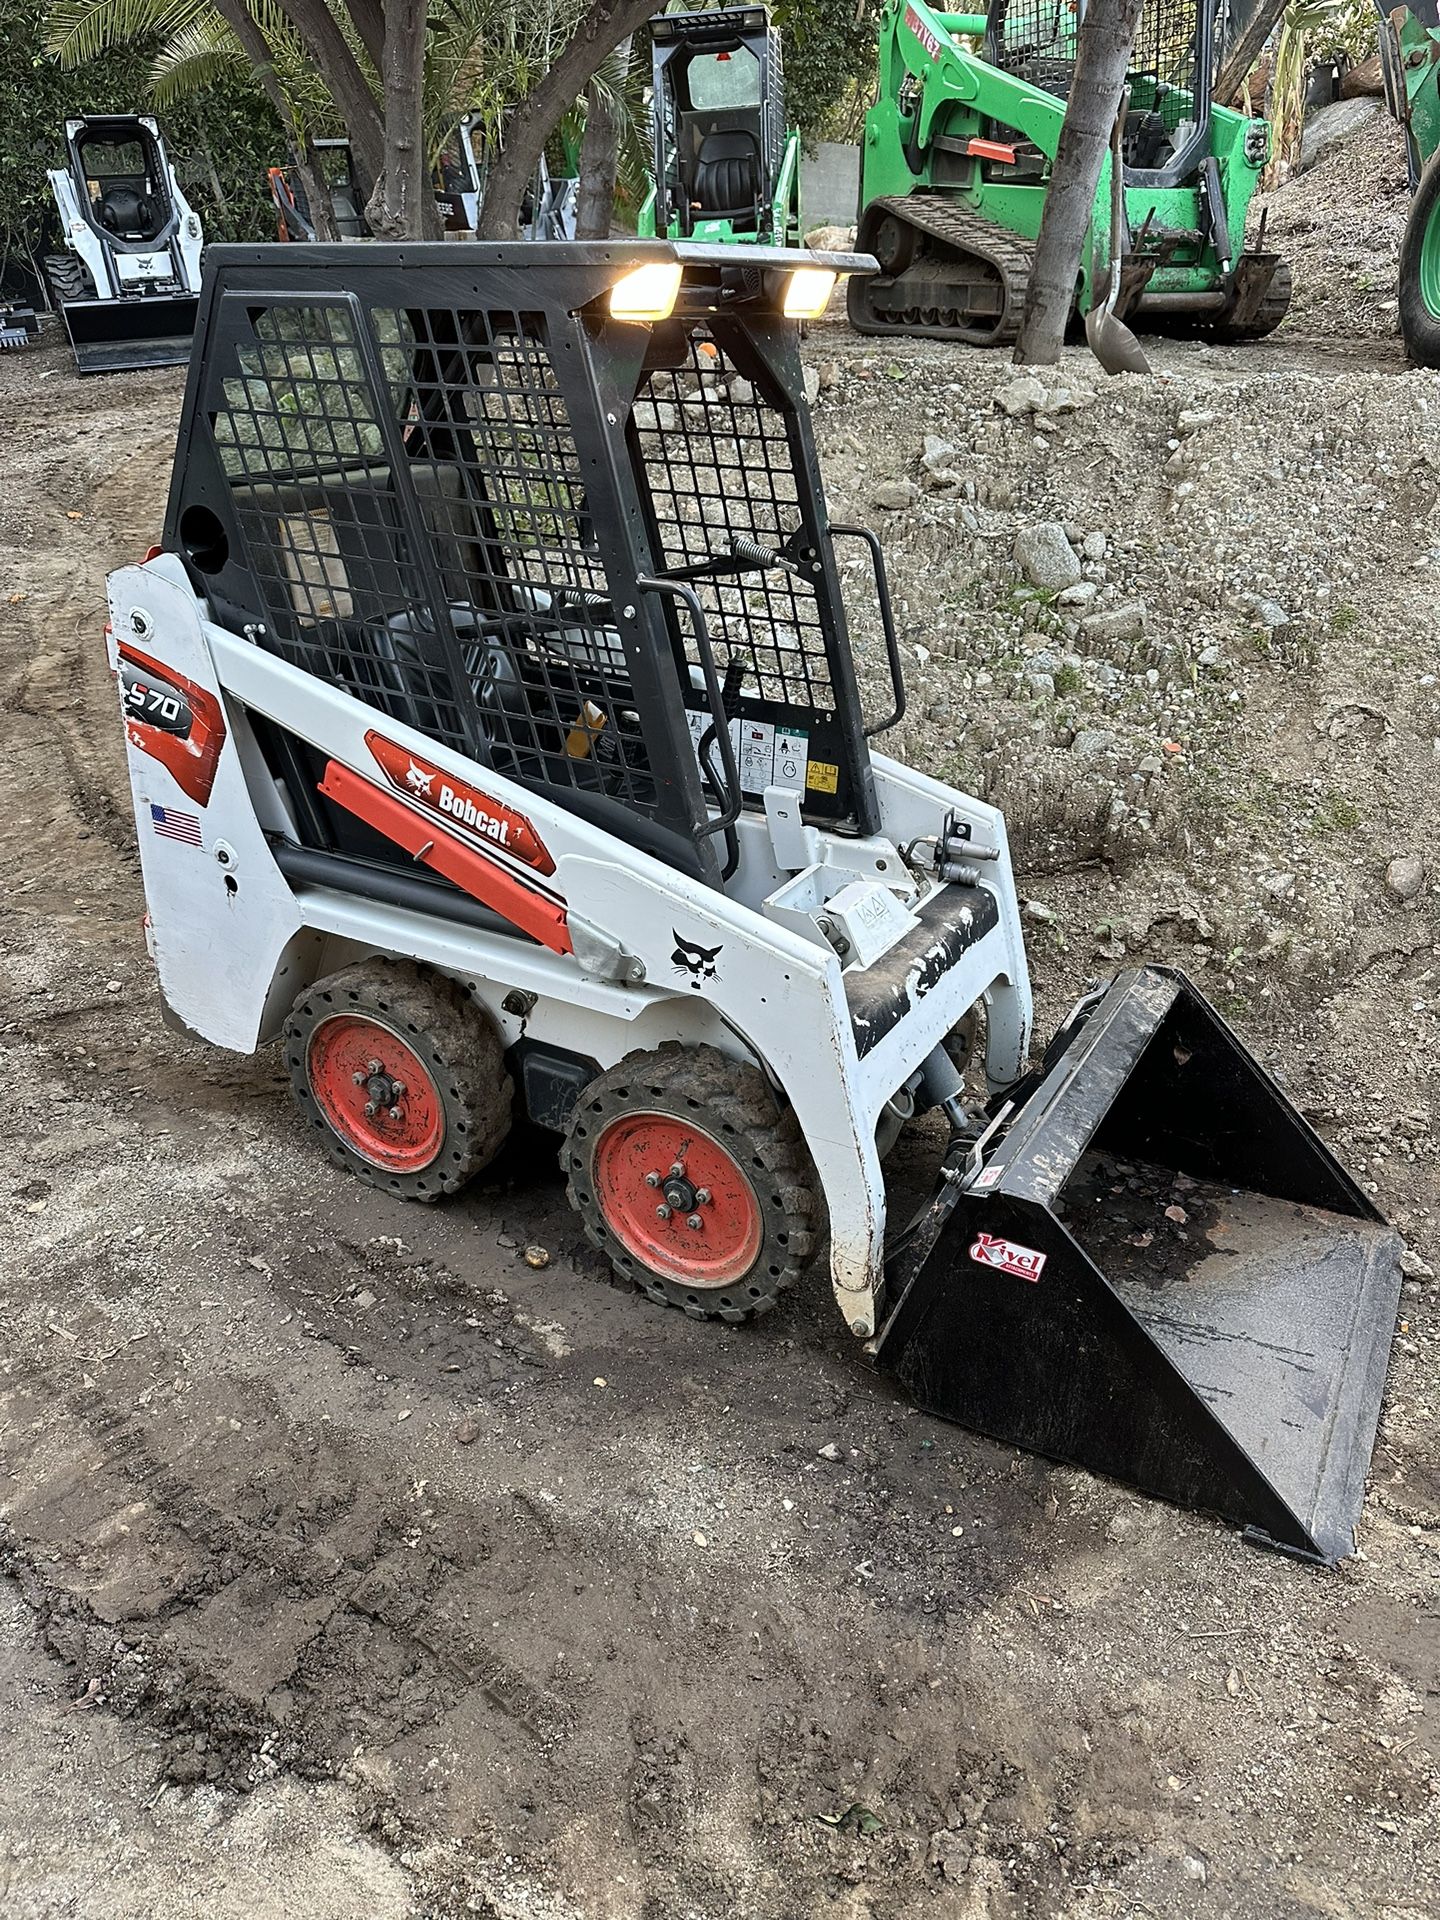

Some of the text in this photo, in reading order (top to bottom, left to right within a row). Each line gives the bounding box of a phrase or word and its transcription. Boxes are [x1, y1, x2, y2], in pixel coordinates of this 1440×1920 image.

[128, 682, 180, 721] S70
[438, 784, 510, 845] Bobcat
[975, 1235, 1041, 1271] Kivel
